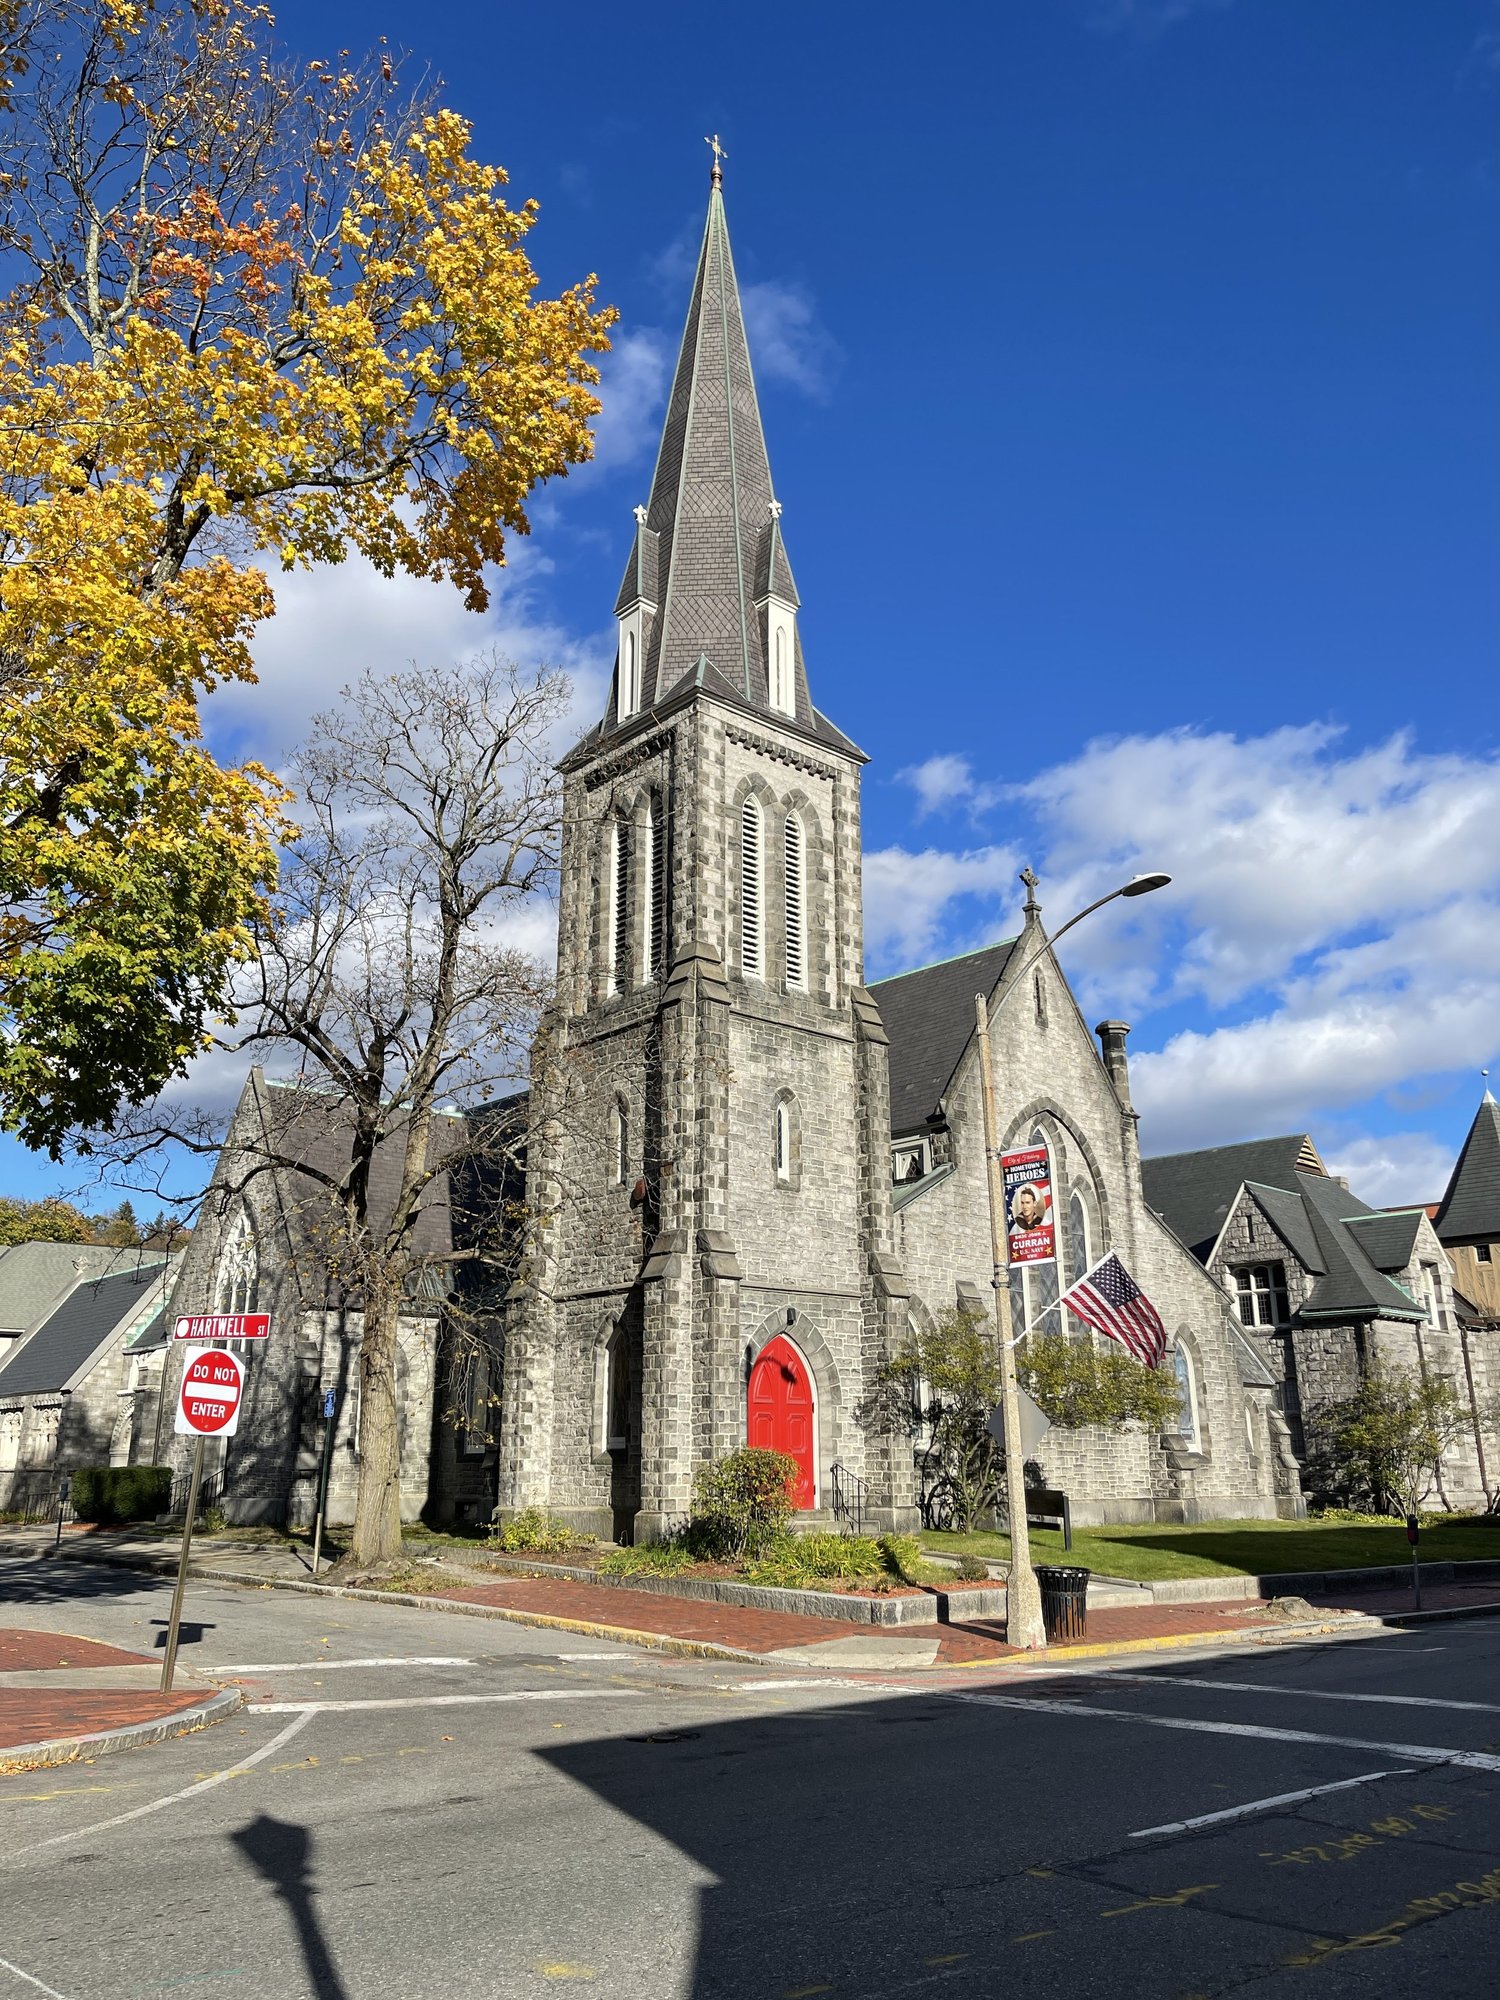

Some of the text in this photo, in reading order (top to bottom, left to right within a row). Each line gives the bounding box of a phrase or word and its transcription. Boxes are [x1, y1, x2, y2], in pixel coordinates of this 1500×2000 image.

[1010, 1161, 1040, 1172] HOMETOWN
[1006, 1167, 1045, 1183] HEROES
[1012, 1237, 1050, 1249] CURRAN
[190, 1317, 265, 1336] HARTWELL ST
[193, 1365, 236, 1382] DO NOT
[191, 1402, 226, 1418] ENTER
